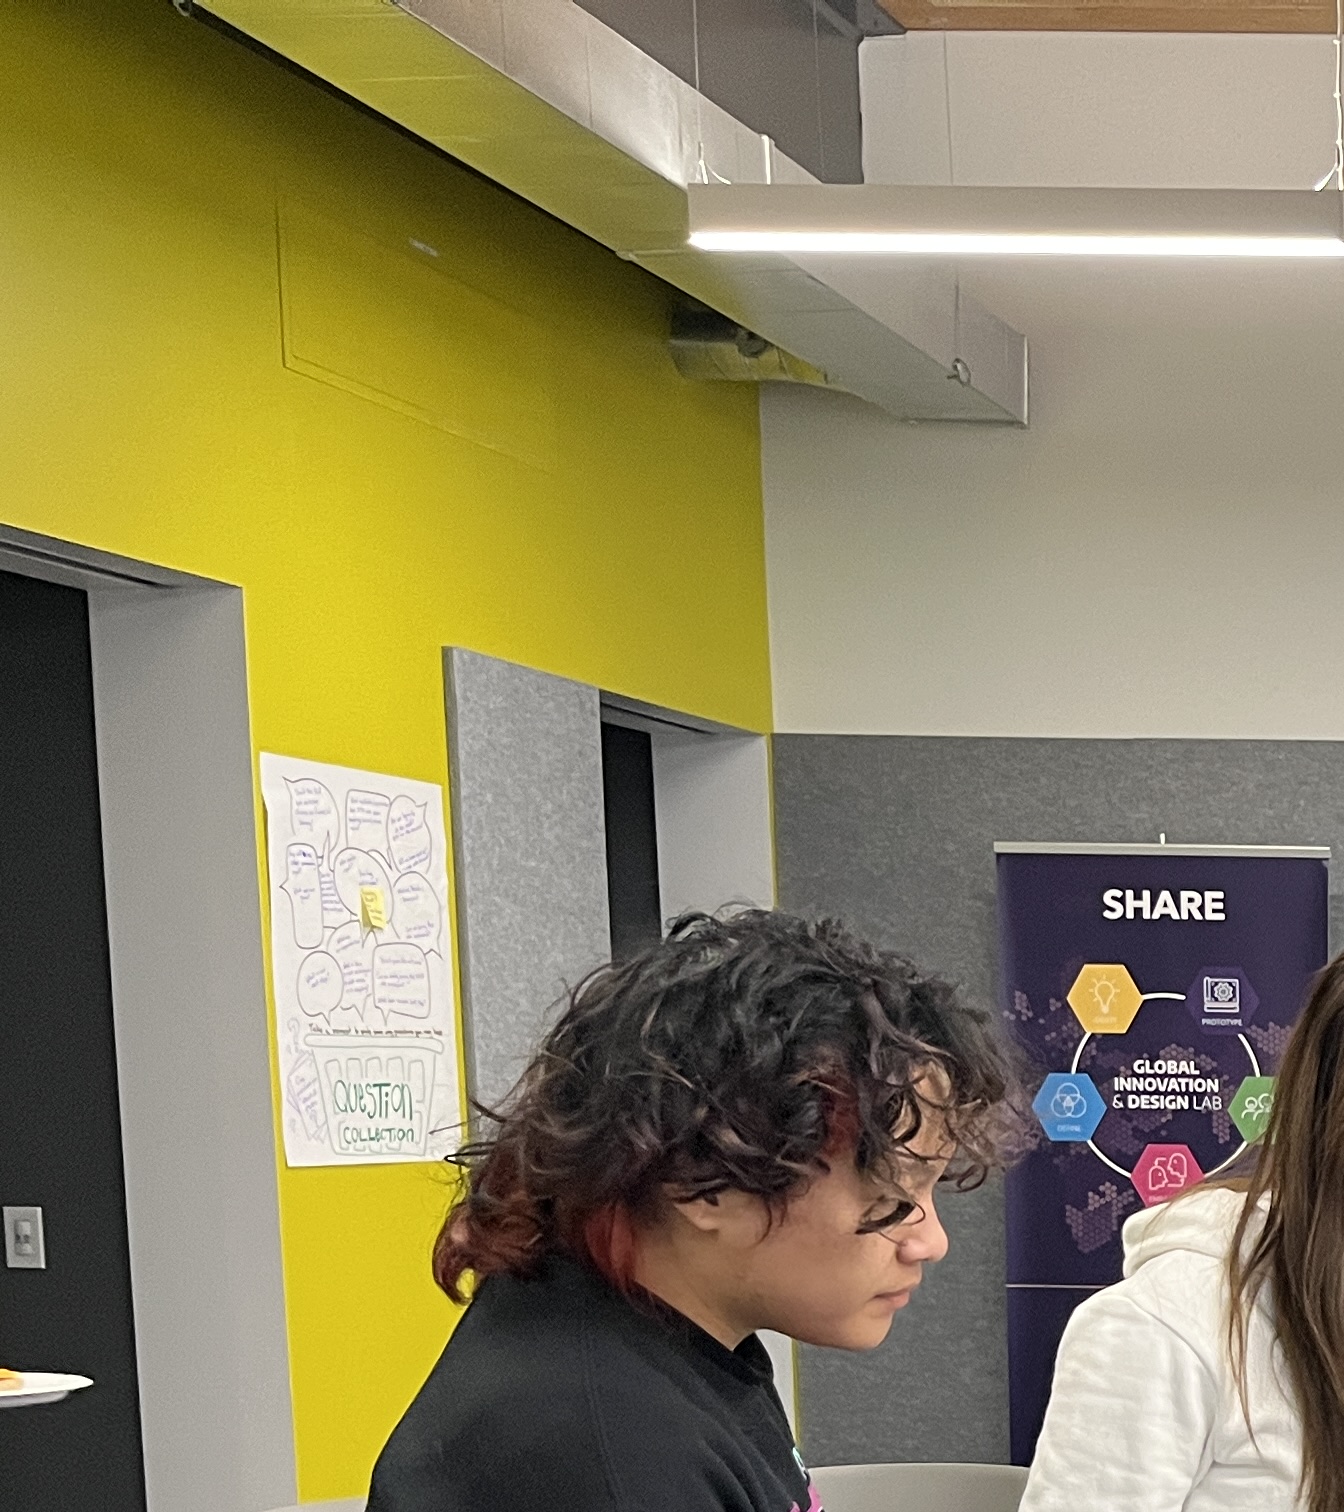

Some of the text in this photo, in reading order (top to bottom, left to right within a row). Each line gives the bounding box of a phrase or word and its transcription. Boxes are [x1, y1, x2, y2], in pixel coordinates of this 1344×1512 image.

[1102, 888, 1226, 921] SHARE
[1201, 1017, 1243, 1027] PROTOTYPE
[1132, 1059, 1200, 1075] GLOBAL
[1113, 1077, 1220, 1093] INNOVATION
[1112, 1094, 1223, 1111] & DESIGN LAB
